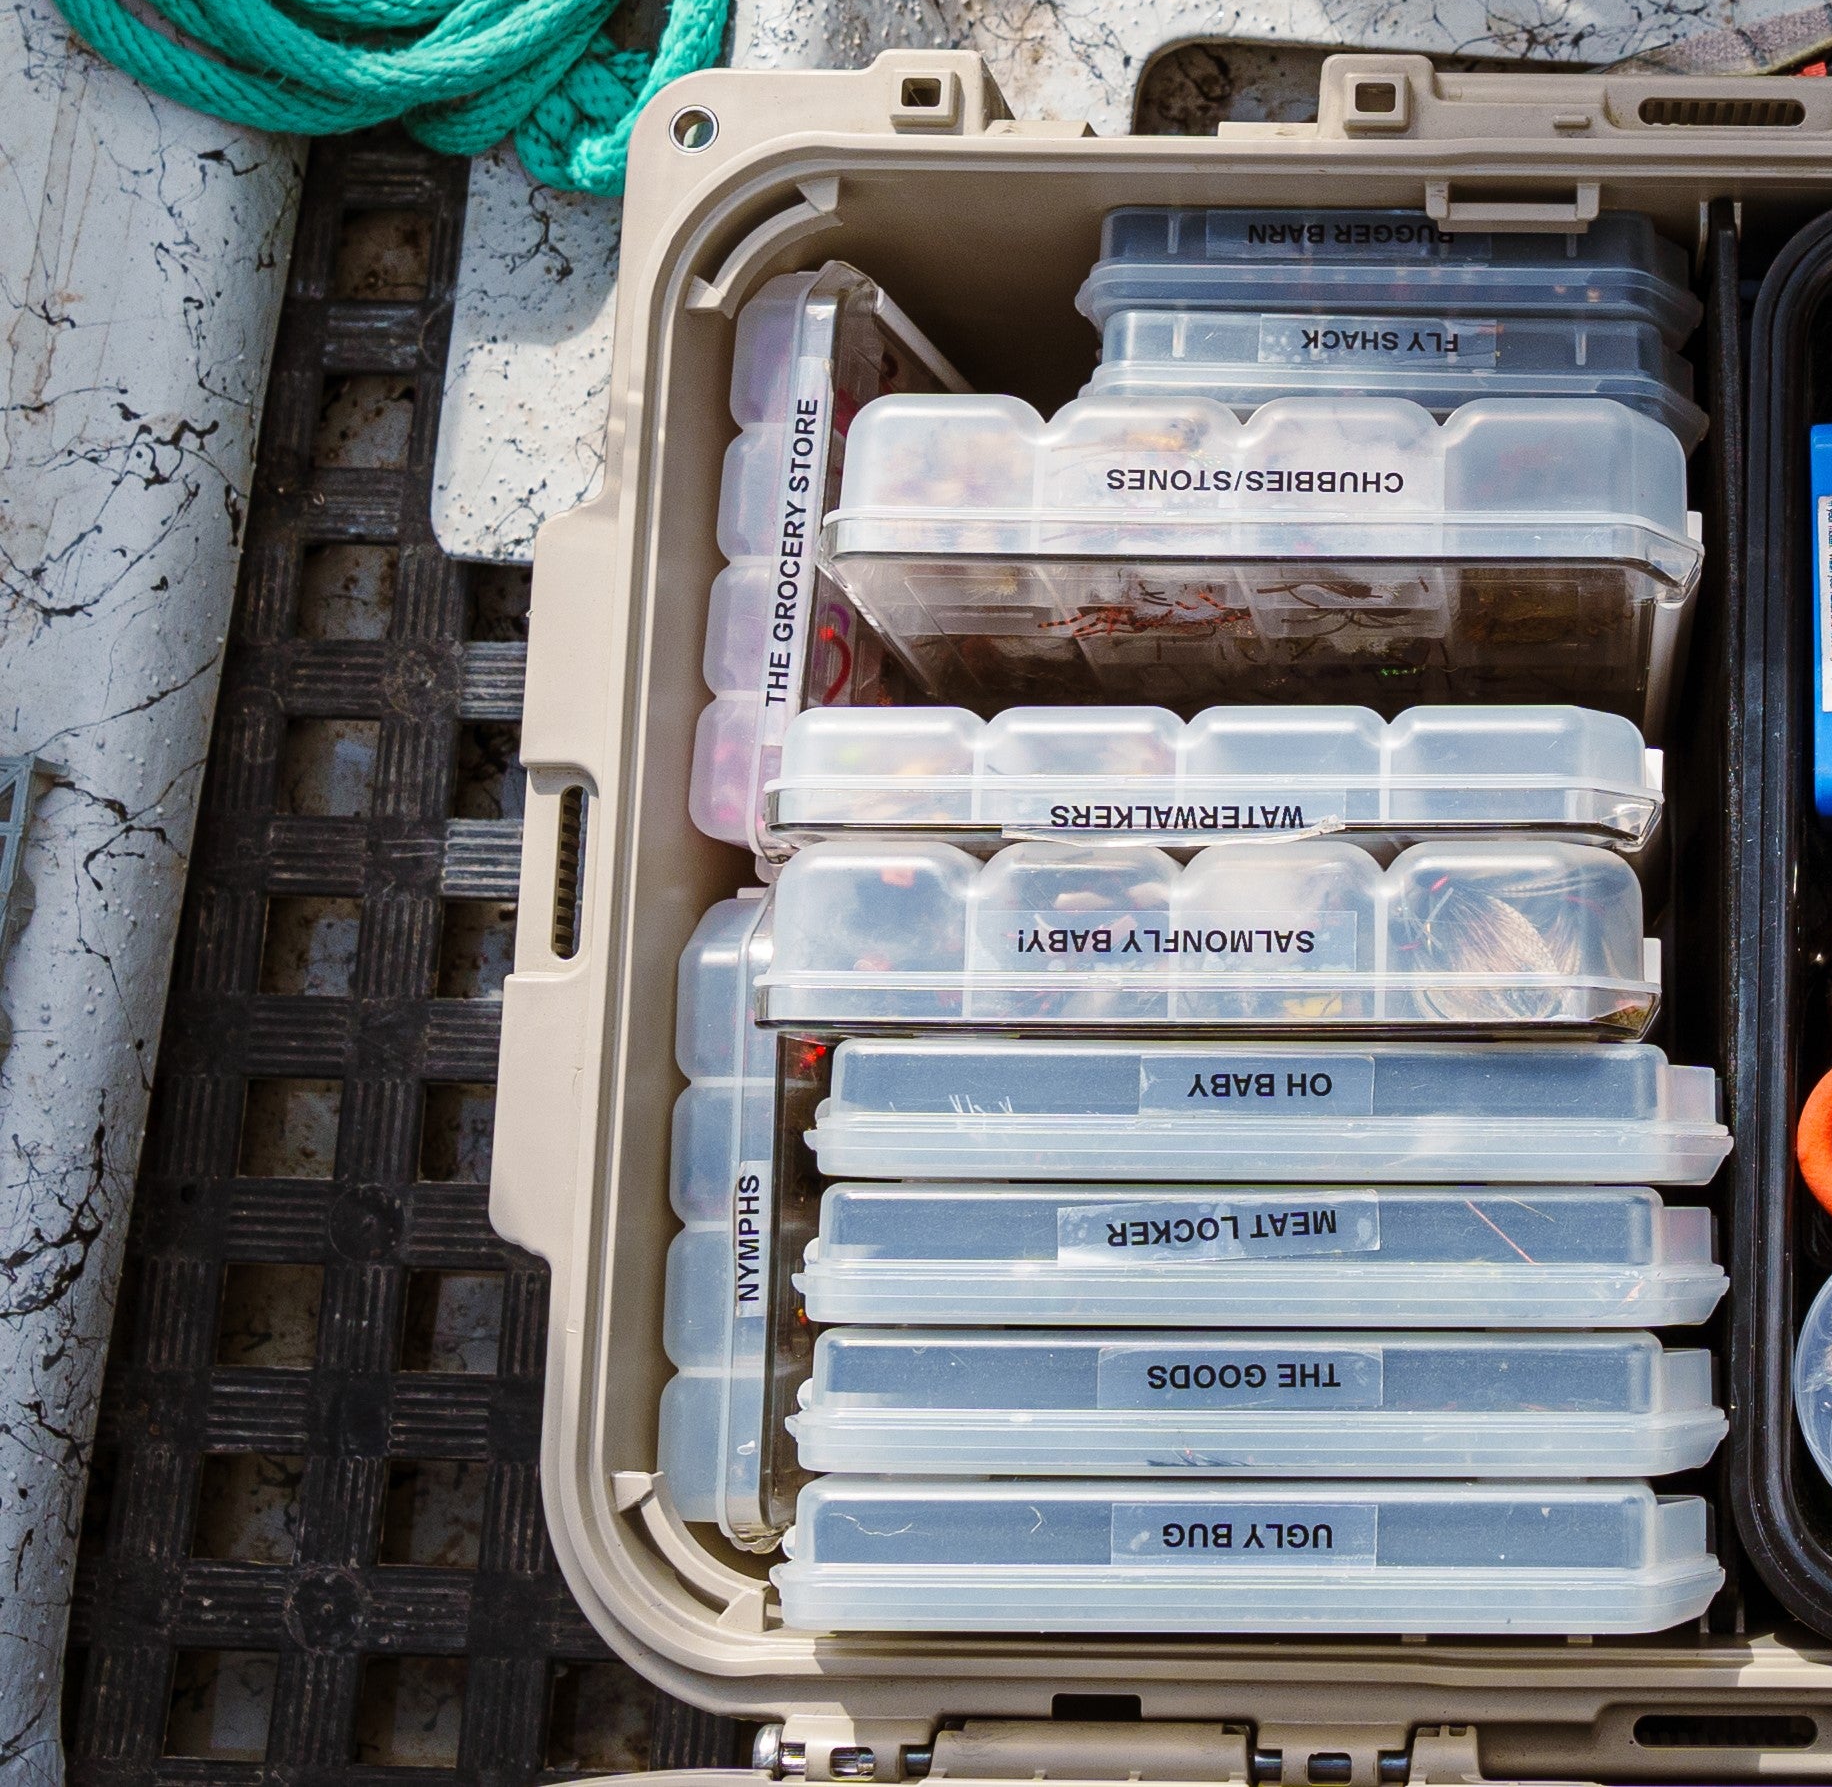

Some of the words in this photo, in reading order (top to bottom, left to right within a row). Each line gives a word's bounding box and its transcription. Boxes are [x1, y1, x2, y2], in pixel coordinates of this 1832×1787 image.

[1247, 223, 1325, 245] BARN
[1333, 222, 1455, 246] BUGGER
[1300, 328, 1400, 352] SHACK
[1406, 330, 1460, 354] FLY
[788, 398, 818, 493] STORE
[1105, 468, 1404, 494] CHUBBIES/STONES
[771, 500, 808, 643] GROCERY
[765, 652, 791, 707] THE
[1049, 804, 1305, 830] WATERWALKERS
[1016, 927, 1113, 954] BABY!
[1119, 926, 1317, 954] SALMONFLY
[1186, 1072, 1275, 1097] BABY
[1287, 1072, 1333, 1097] OH
[1105, 1214, 1240, 1247] LOCKER
[1249, 1208, 1337, 1238] MEAT
[738, 1174, 760, 1302] NYMPHS
[1146, 1362, 1267, 1390] GOODS
[1274, 1362, 1341, 1388] THE
[1160, 1522, 1233, 1549] BUG
[1243, 1522, 1334, 1549] UGLY
